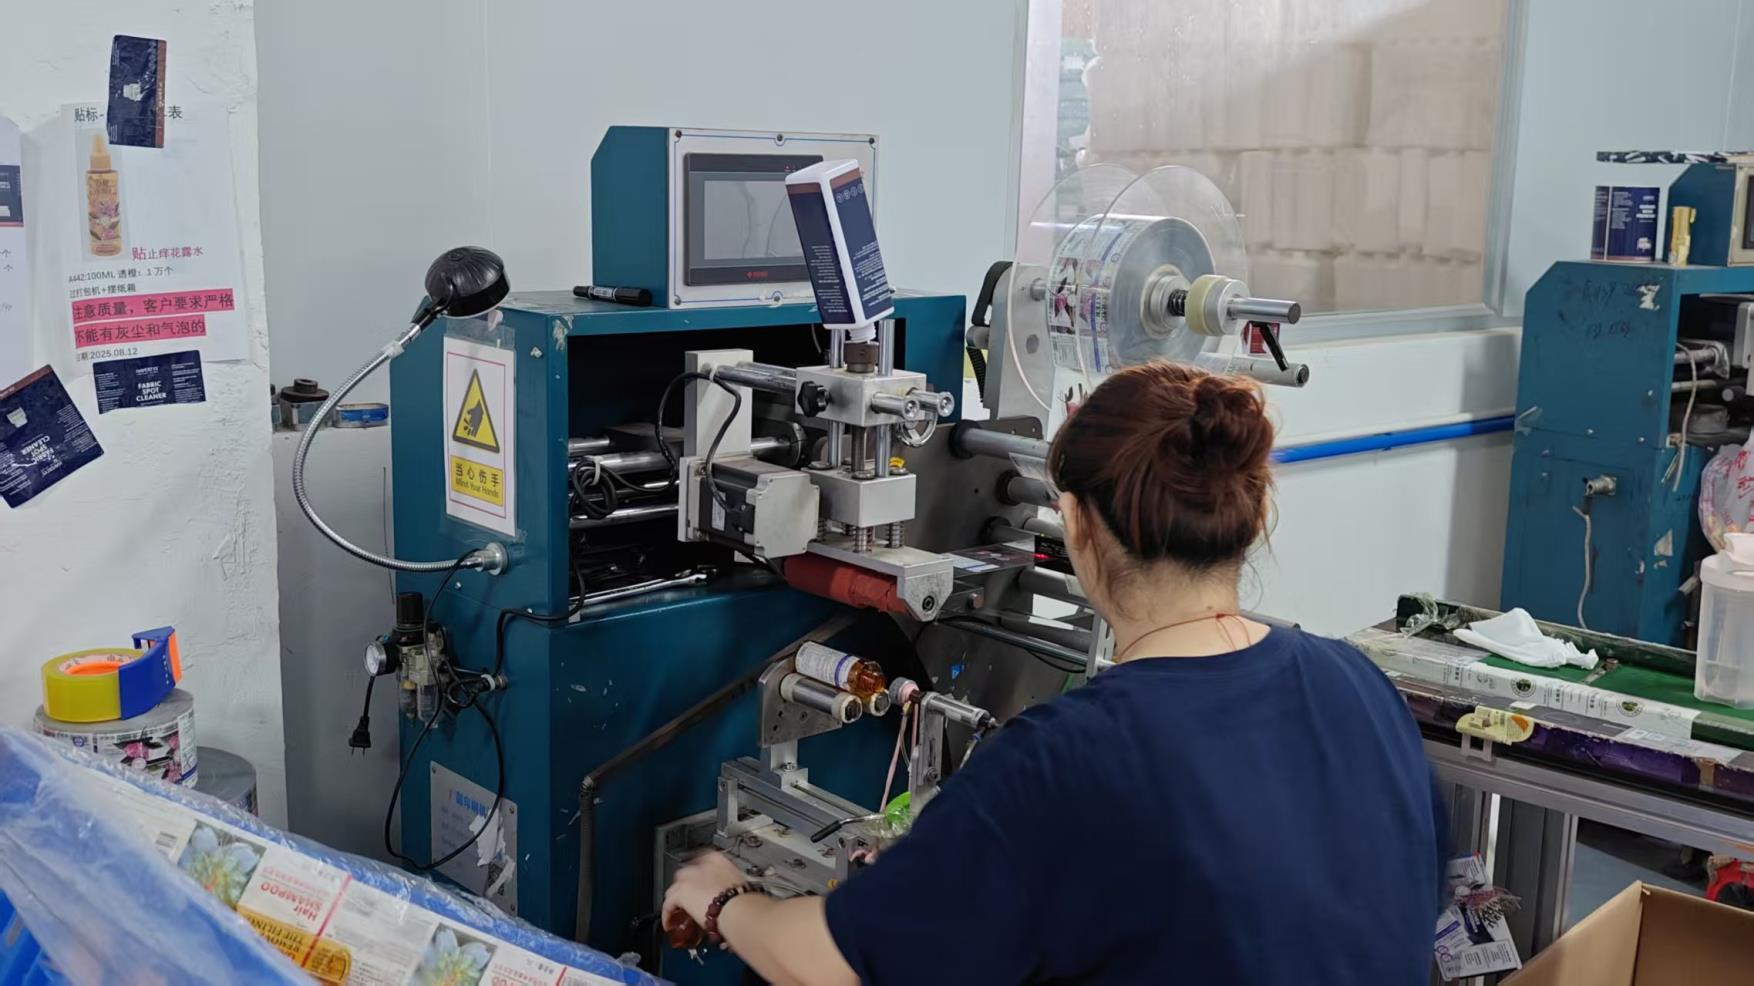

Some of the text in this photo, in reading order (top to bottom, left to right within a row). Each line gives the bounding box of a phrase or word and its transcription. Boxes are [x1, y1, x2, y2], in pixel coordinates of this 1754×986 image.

[132, 247, 203, 261] 贴止痒花露水
[138, 381, 162, 389] FABRIC
[136, 392, 167, 402] CLEANER
[456, 464, 498, 487] 当心伤手
[260, 882, 322, 910] SHAMPOO
[292, 905, 318, 922] Hair
